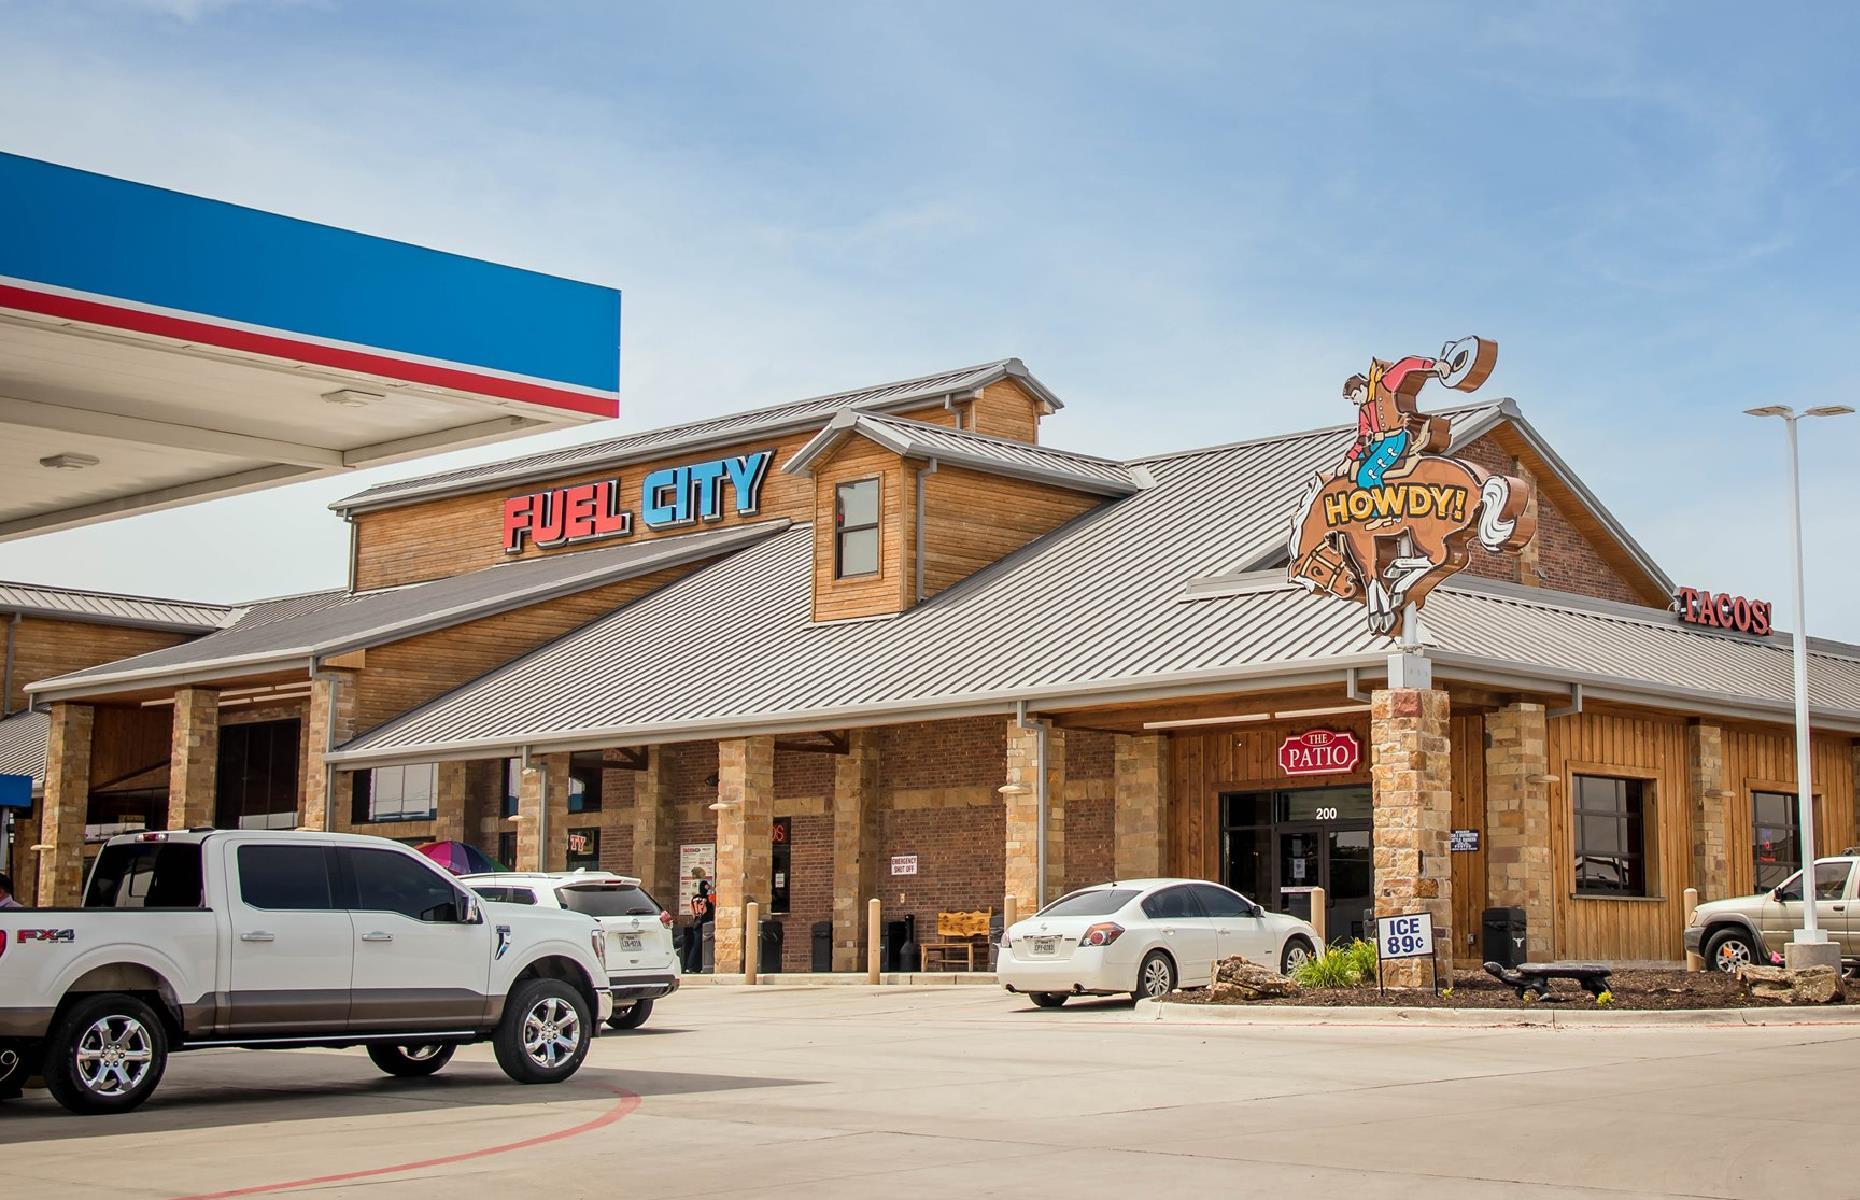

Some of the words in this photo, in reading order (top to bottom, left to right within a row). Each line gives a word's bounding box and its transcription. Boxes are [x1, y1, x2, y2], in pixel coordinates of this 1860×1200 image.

[504, 478, 632, 553] FUEL
[641, 450, 775, 531] CITY
[1324, 483, 1467, 526] HOWDY!
[1678, 586, 1774, 636] TACOS!
[1308, 733, 1328, 745] THE
[1288, 745, 1349, 768] PATIO
[1315, 807, 1338, 820] 200
[16, 928, 75, 944] FX4
[1389, 918, 1420, 936] ICE
